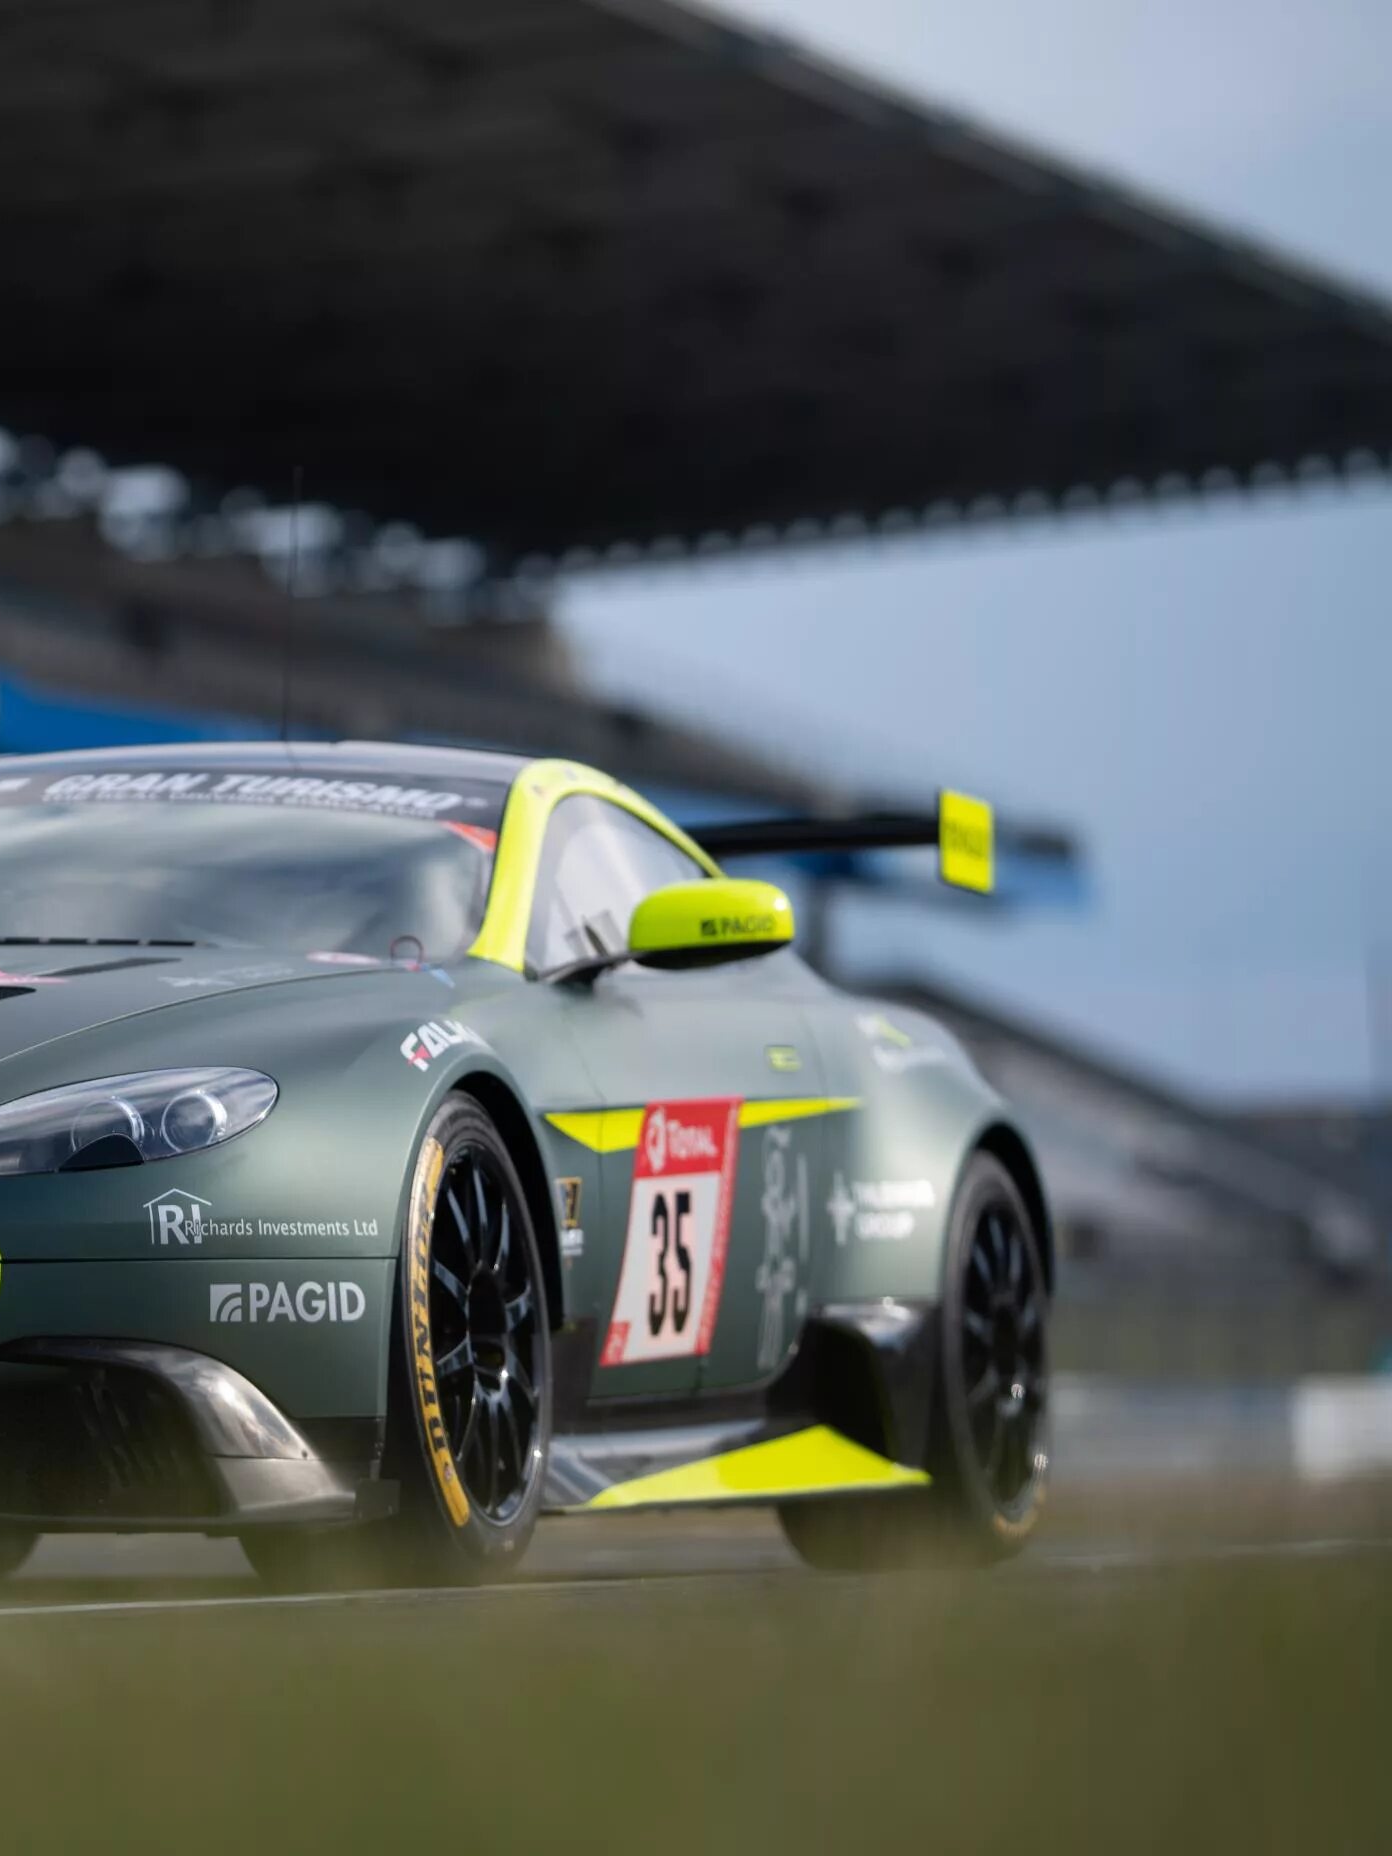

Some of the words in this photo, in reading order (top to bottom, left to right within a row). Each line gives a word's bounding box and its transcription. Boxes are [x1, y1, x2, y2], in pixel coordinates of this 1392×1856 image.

[44, 773, 209, 795] GRAN
[211, 773, 463, 810] TURISMO
[185, 1218, 253, 1237] Richards
[258, 1219, 350, 1237] Investments
[354, 1218, 379, 1237] Ltd
[649, 1191, 691, 1337] 35
[249, 1280, 367, 1323] PAGID
